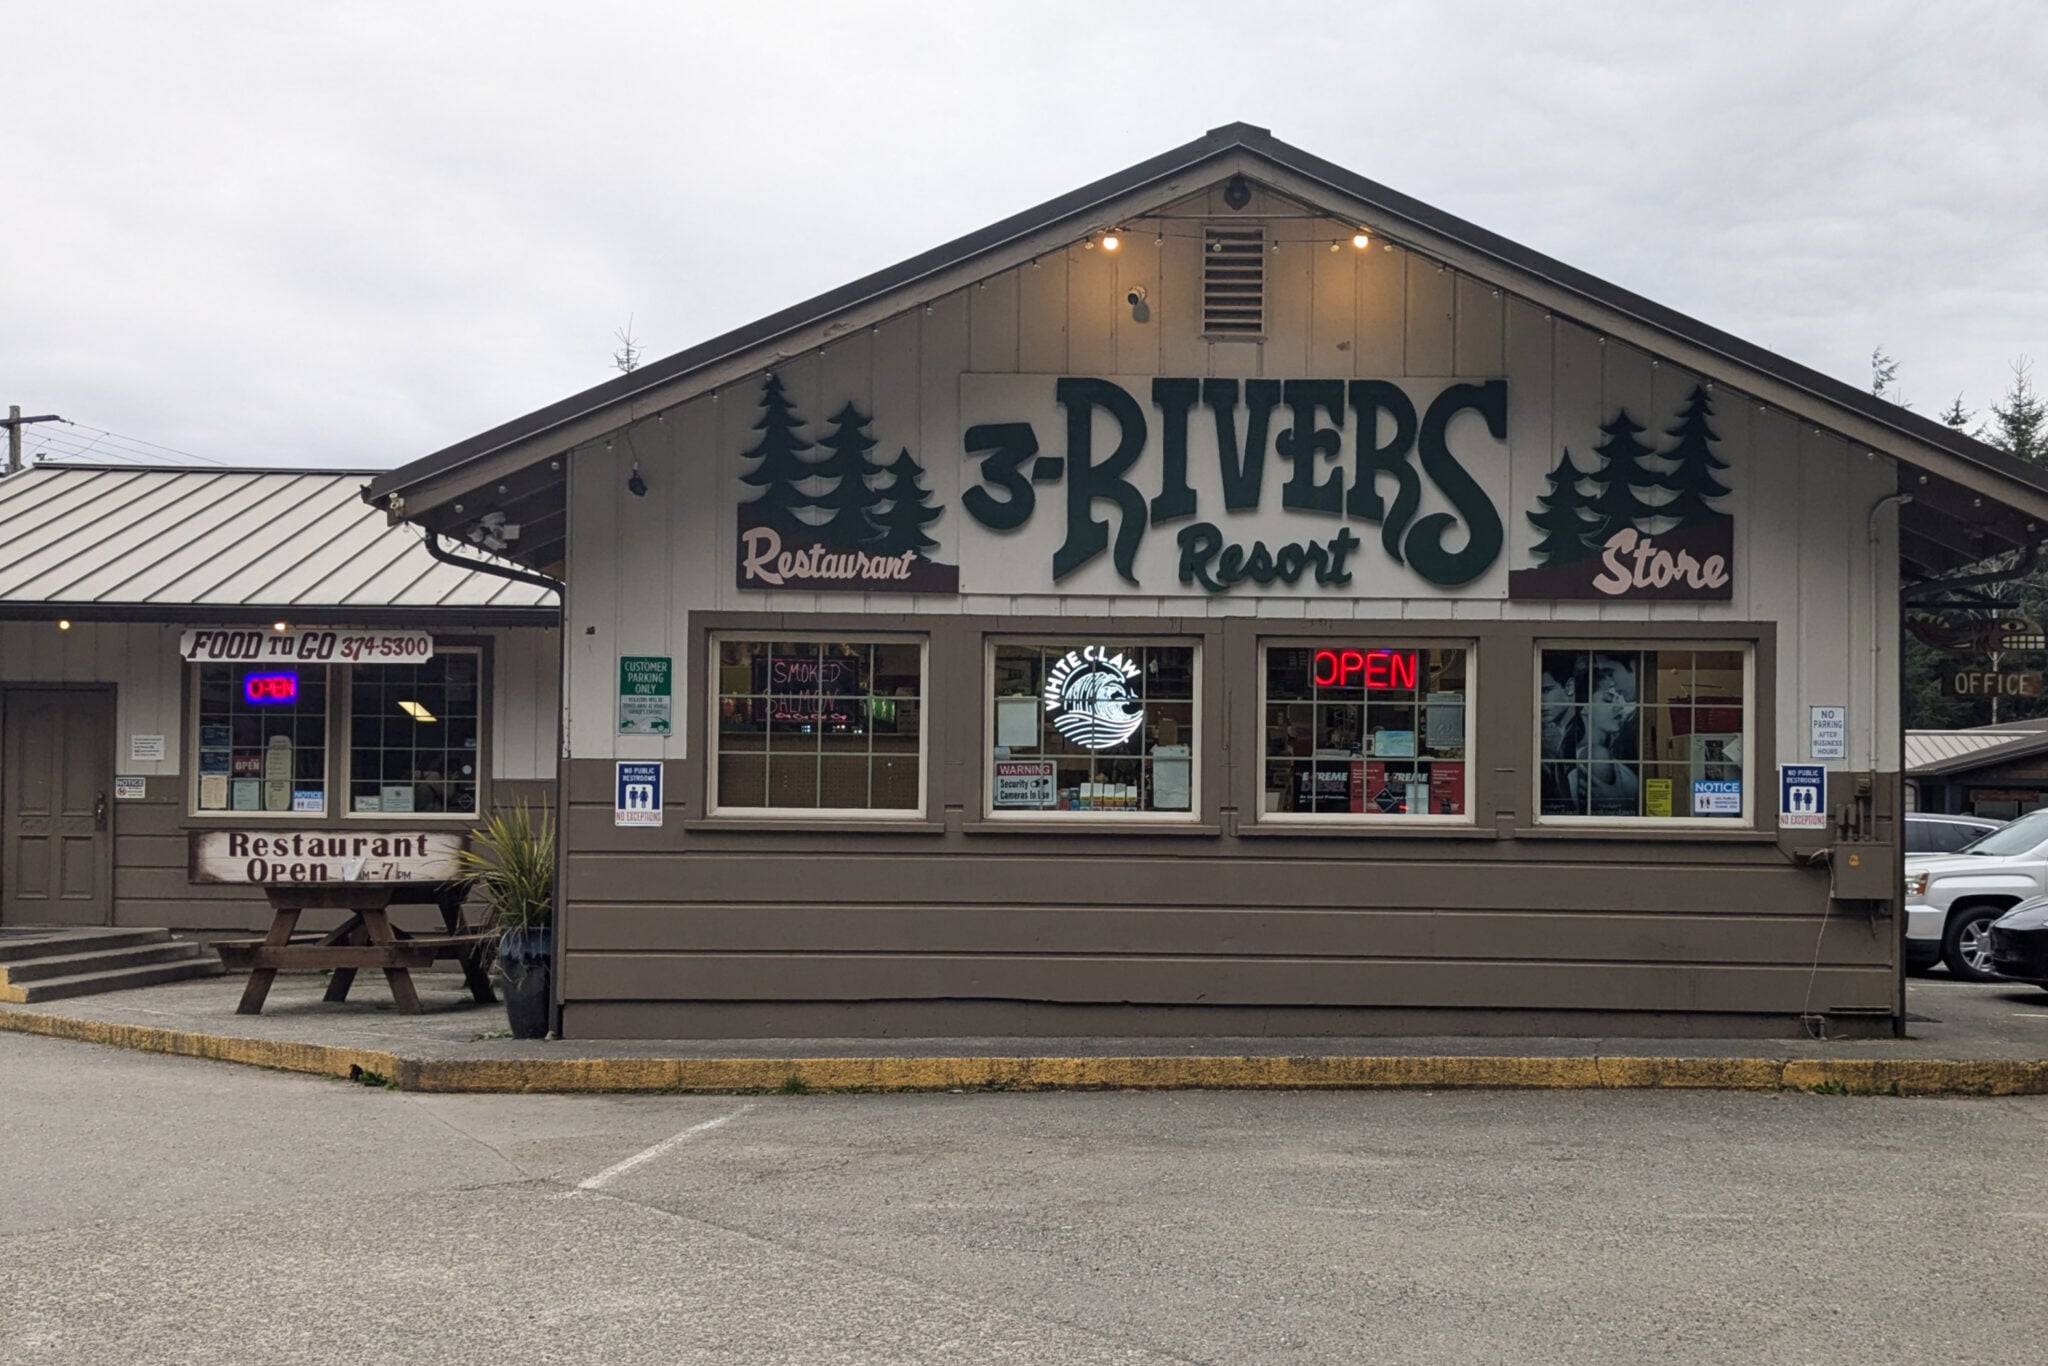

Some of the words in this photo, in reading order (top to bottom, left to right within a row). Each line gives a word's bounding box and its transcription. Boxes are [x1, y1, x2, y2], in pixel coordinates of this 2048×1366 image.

[742, 526, 918, 585] Restaurant
[1176, 522, 1361, 593] Resort
[1592, 527, 1730, 595] Store
[188, 631, 264, 660] FOOD
[268, 636, 294, 655] TO
[297, 632, 337, 660] GO
[340, 636, 429, 661] 374-5300
[624, 660, 668, 672] CUSTOMER
[773, 661, 841, 683] SMOKED
[1314, 650, 1417, 690] OPEN
[627, 672, 664, 683] PARKING
[1045, 650, 1082, 712] WHITE
[1083, 645, 1142, 680] CLAW
[1954, 672, 2029, 695] OFFICE
[249, 676, 296, 699] OPEN
[635, 683, 657, 695] ONLY
[762, 687, 840, 714] SALMON
[1820, 710, 1835, 719] NO
[1813, 720, 1843, 729] PARKING
[235, 760, 260, 771] OPEN
[1000, 764, 1050, 775] WARNING
[1000, 778, 1029, 790] Security
[1694, 782, 1740, 792] NOTICE
[1000, 790, 1029, 800] Cameras
[1030, 790, 1037, 800] In
[616, 811, 625, 821] NO
[627, 811, 661, 821] EXCEPTIONS
[1780, 815, 1789, 825] NO
[1790, 815, 1825, 825] EXCEPTIONS
[228, 832, 429, 858] Restaurant
[247, 858, 328, 881] Open
